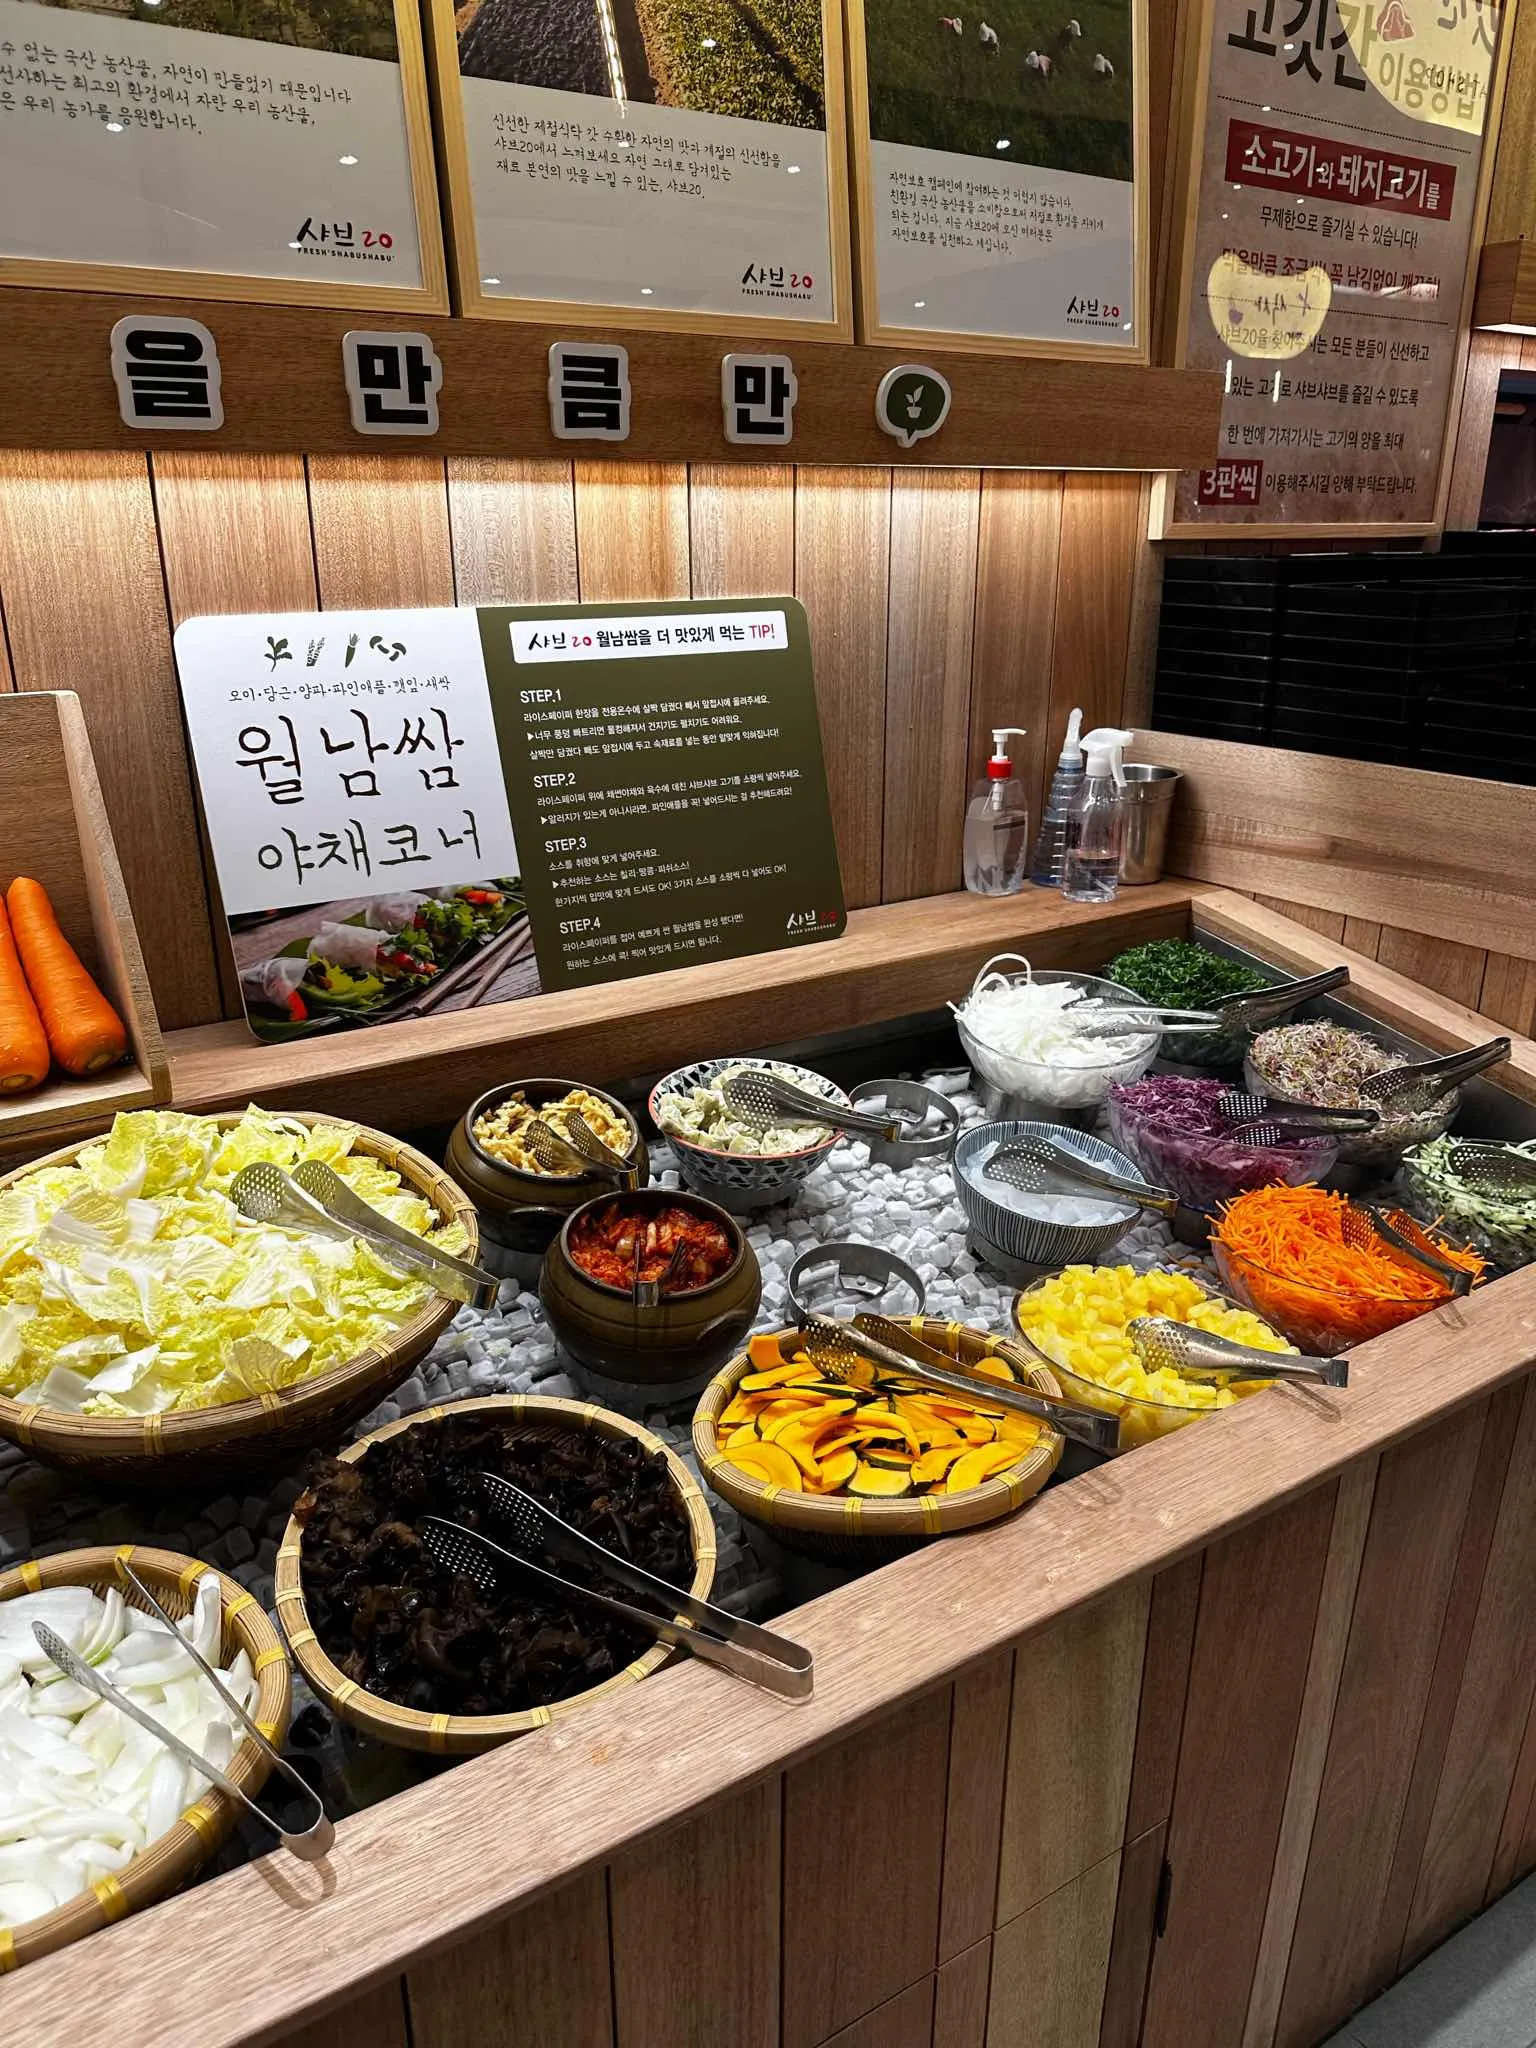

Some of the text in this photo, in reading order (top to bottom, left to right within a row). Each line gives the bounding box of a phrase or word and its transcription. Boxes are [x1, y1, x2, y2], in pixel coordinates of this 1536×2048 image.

[24, 42, 57, 63] 없는
[64, 50, 96, 70] 국산
[164, 63, 208, 85] 자연이
[215, 71, 272, 94] 만들었기
[24, 96, 55, 113] 우리
[196, 92, 226, 112] 자란
[233, 99, 261, 115] 우리
[494, 113, 529, 133] 신선한
[587, 127, 598, 142] 갓
[642, 135, 673, 153] 자연의
[740, 148, 781, 168] 신선함을
[494, 136, 557, 157] 샤브20에서
[625, 153, 647, 170] 자연
[652, 158, 685, 173] 그대로
[497, 159, 521, 173] 재료
[525, 162, 560, 180] 본연의
[567, 167, 589, 184] 맛을
[622, 175, 632, 188] 수
[1241, 135, 1440, 210] 소고기와 돼지고기를
[1260, 206, 1418, 249] 무제한으로 즐기실 수 있습니다!
[1331, 264, 1344, 283] 꼭
[1332, 336, 1353, 355] 모든
[1355, 338, 1388, 360] 분들이
[1390, 341, 1430, 362] 신선하고
[124, 329, 791, 436] 을 만 큼 만
[1294, 380, 1349, 404] 샤브샤브를
[1352, 384, 1373, 405] 즐길
[1376, 386, 1386, 402] 수
[1389, 386, 1419, 407] 있도록
[1227, 424, 1405, 450] 한 번에 가져가시는 고기의 양을 최대
[1203, 464, 1258, 500] 3판씩
[1265, 473, 1330, 494] 이용해주시길
[1332, 476, 1354, 494] 양해
[596, 629, 651, 648] 월남쌈을
[657, 628, 670, 644] 더
[675, 626, 715, 644] 맛있게
[720, 625, 744, 641] 먹는
[749, 623, 775, 640] TIP!
[520, 688, 561, 703] STEP.1
[236, 708, 464, 804] 월남쌈
[533, 772, 576, 788] STEP.2
[545, 837, 587, 853] STEP.3
[560, 916, 601, 934] STEP.4
